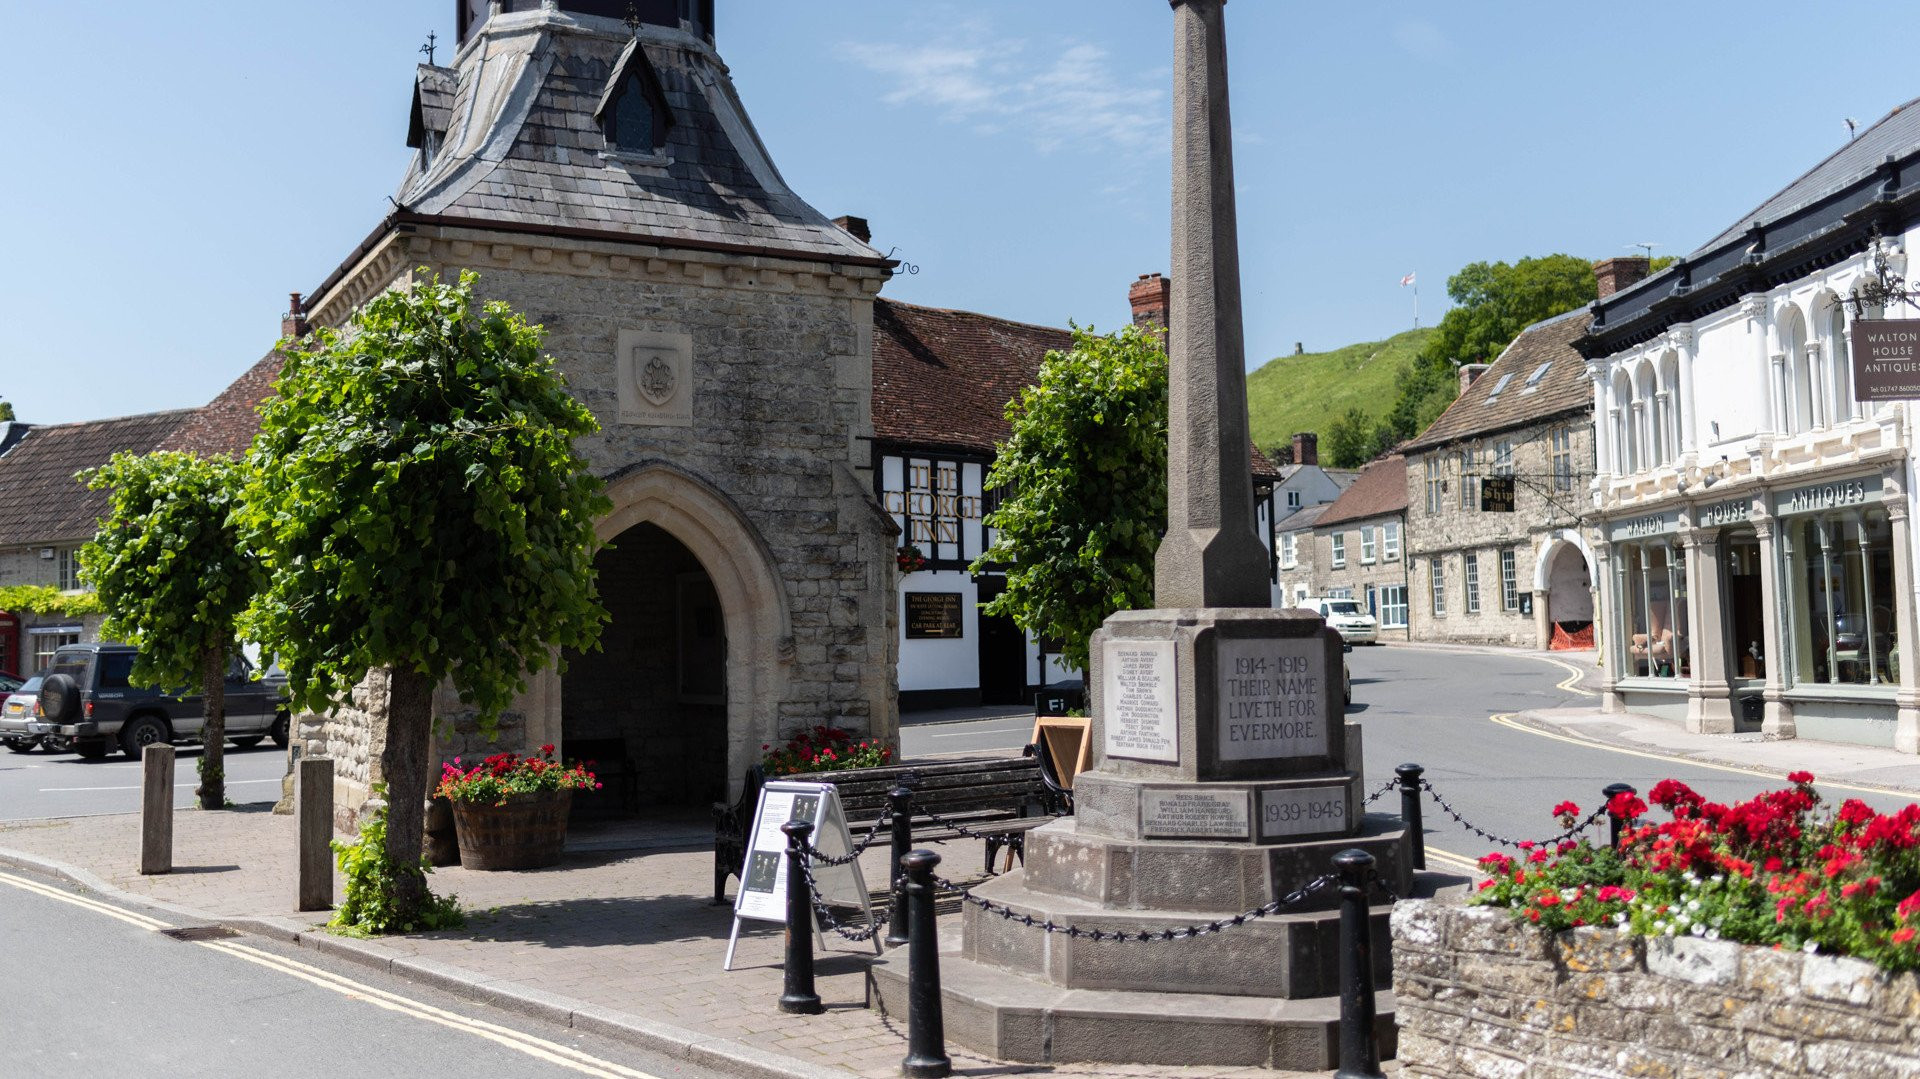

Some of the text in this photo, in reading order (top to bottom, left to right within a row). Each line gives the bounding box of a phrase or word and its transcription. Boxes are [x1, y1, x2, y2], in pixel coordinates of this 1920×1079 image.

[1868, 333, 1917, 342] WALTON
[1872, 346, 1912, 356] HOUSE
[910, 464, 957, 491] THE
[1484, 487, 1513, 502] Ship
[1791, 482, 1864, 508] ANTIQUES
[884, 491, 982, 520] GEORGE
[1706, 502, 1745, 522] HOUSE
[911, 518, 958, 544] INN
[1626, 515, 1664, 536] WALTON
[1228, 678, 1316, 697] THEIR NAME
[1229, 700, 1316, 719] LIVETH FOR
[1230, 722, 1317, 742] EVERMORE.
